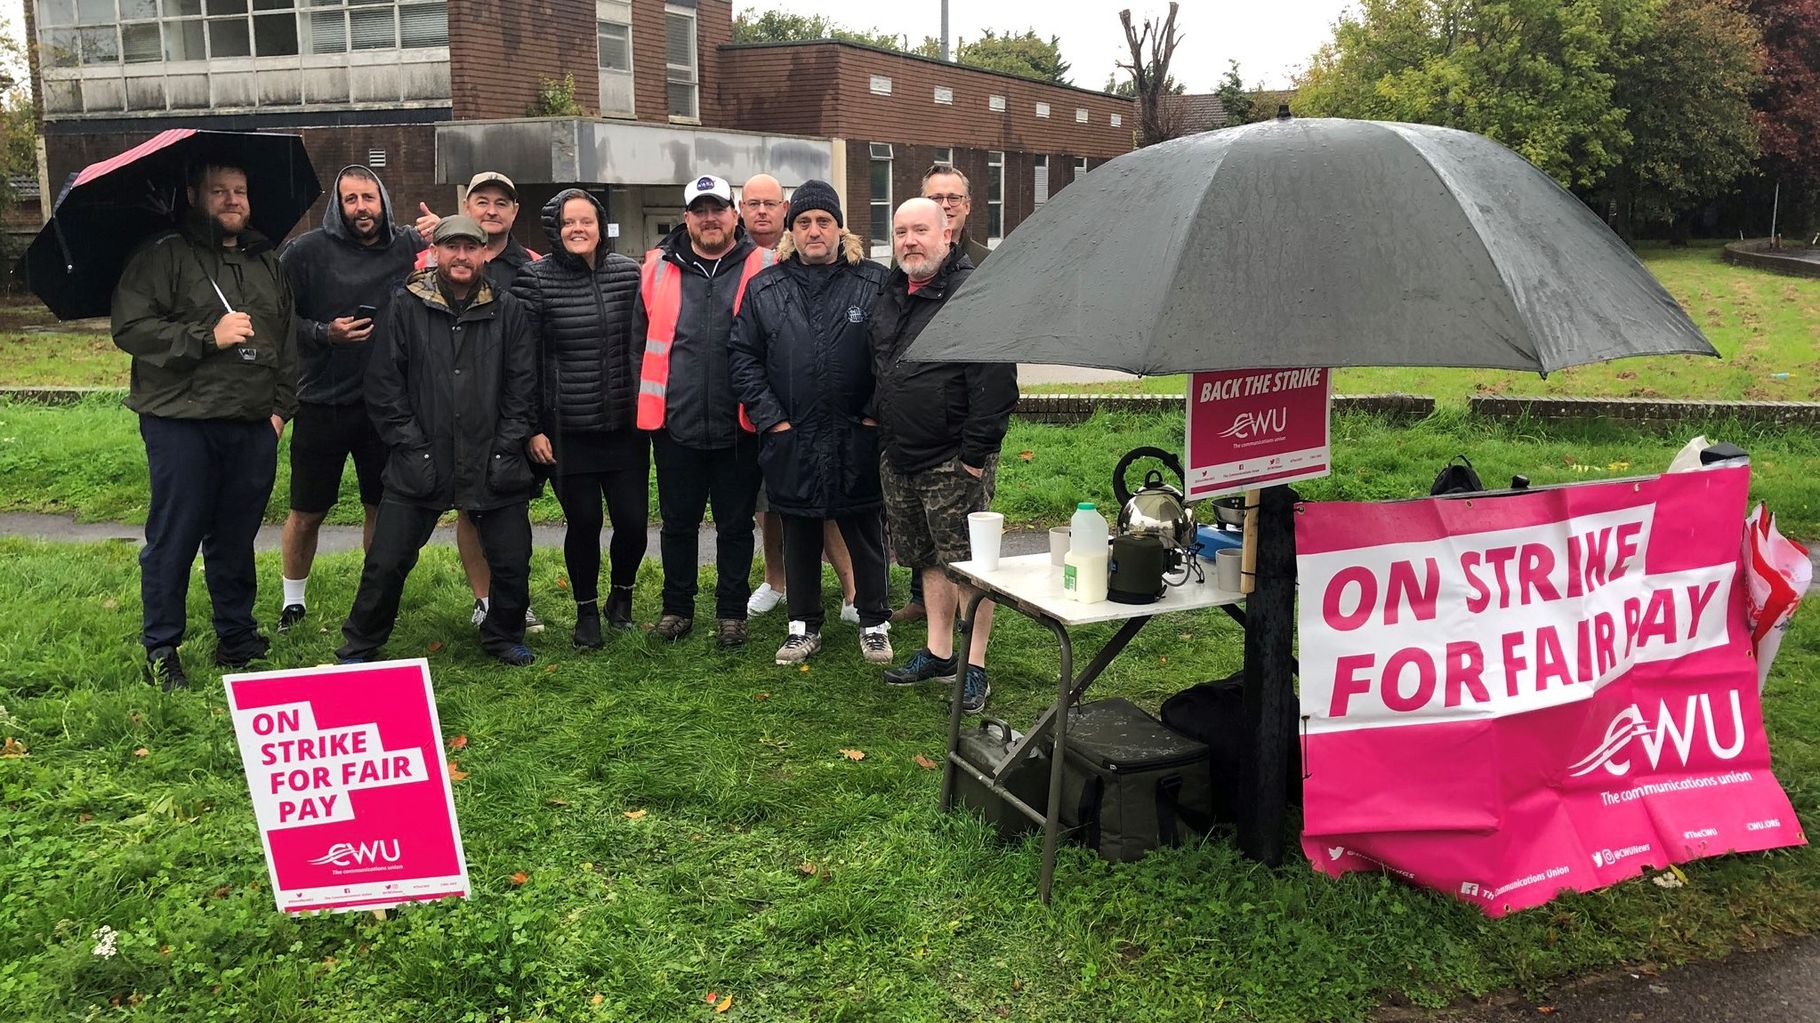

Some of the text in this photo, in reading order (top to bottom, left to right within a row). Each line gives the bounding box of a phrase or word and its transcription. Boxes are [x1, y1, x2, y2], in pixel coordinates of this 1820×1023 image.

[1200, 368, 1322, 403] BACK THE STRIKE
[1217, 407, 1287, 438] CWU
[1322, 521, 1643, 631] ON STRIKE
[1329, 580, 1721, 717] FOR FAIR PAY
[252, 709, 300, 736] ON
[1568, 689, 1745, 777] CWU
[261, 730, 367, 766] STRIKE
[271, 756, 412, 795] FOR FAIR
[1600, 770, 1752, 806] The communications union
[279, 794, 338, 823] PAY
[307, 838, 400, 866] CWU
[1546, 865, 1570, 879] Union
